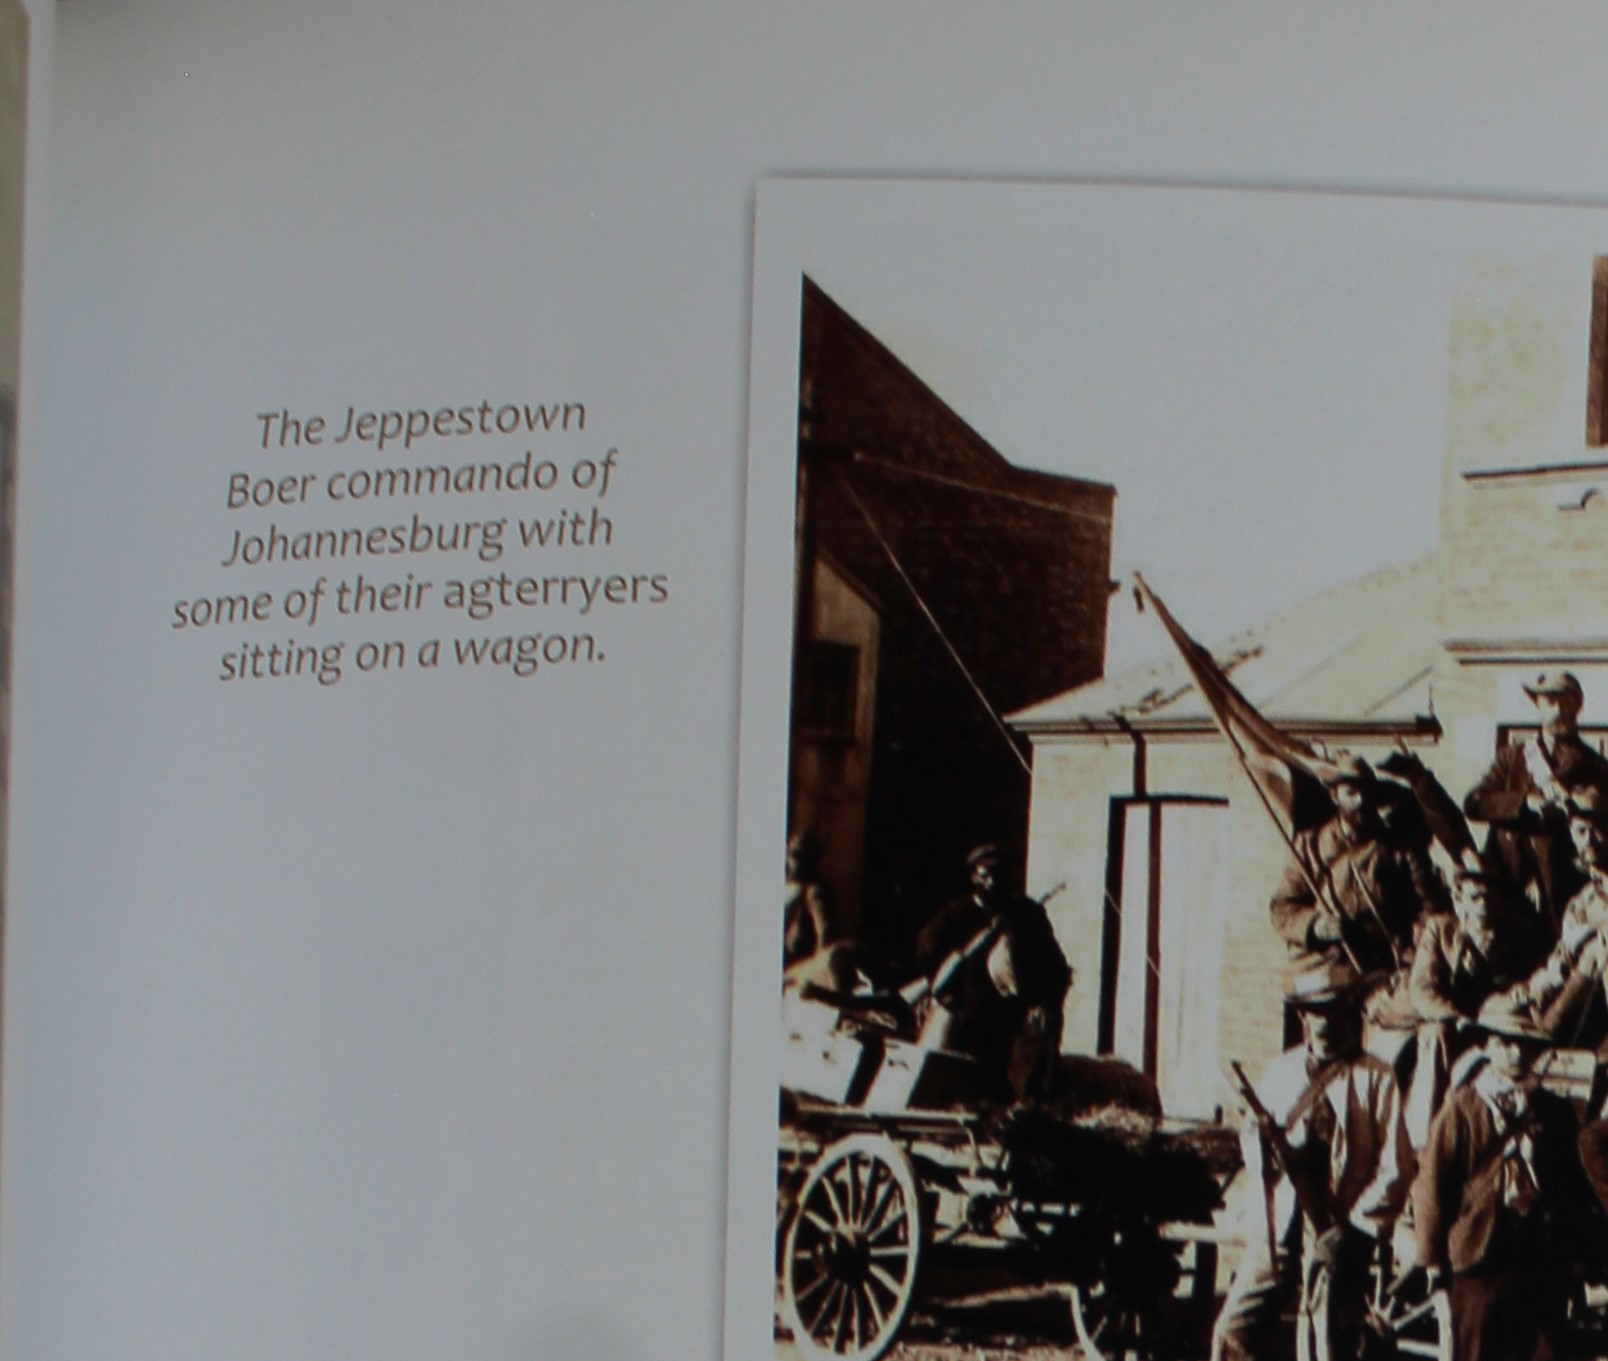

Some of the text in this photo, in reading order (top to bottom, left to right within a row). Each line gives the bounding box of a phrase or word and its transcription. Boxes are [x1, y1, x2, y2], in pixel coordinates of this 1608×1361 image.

[257, 400, 585, 451] The Jeppestown
[227, 447, 618, 509] Boer commando of
[221, 506, 612, 567] Johannesburg with
[172, 572, 668, 629] some of their agterryers
[219, 633, 605, 686] sitting on a wagon.
